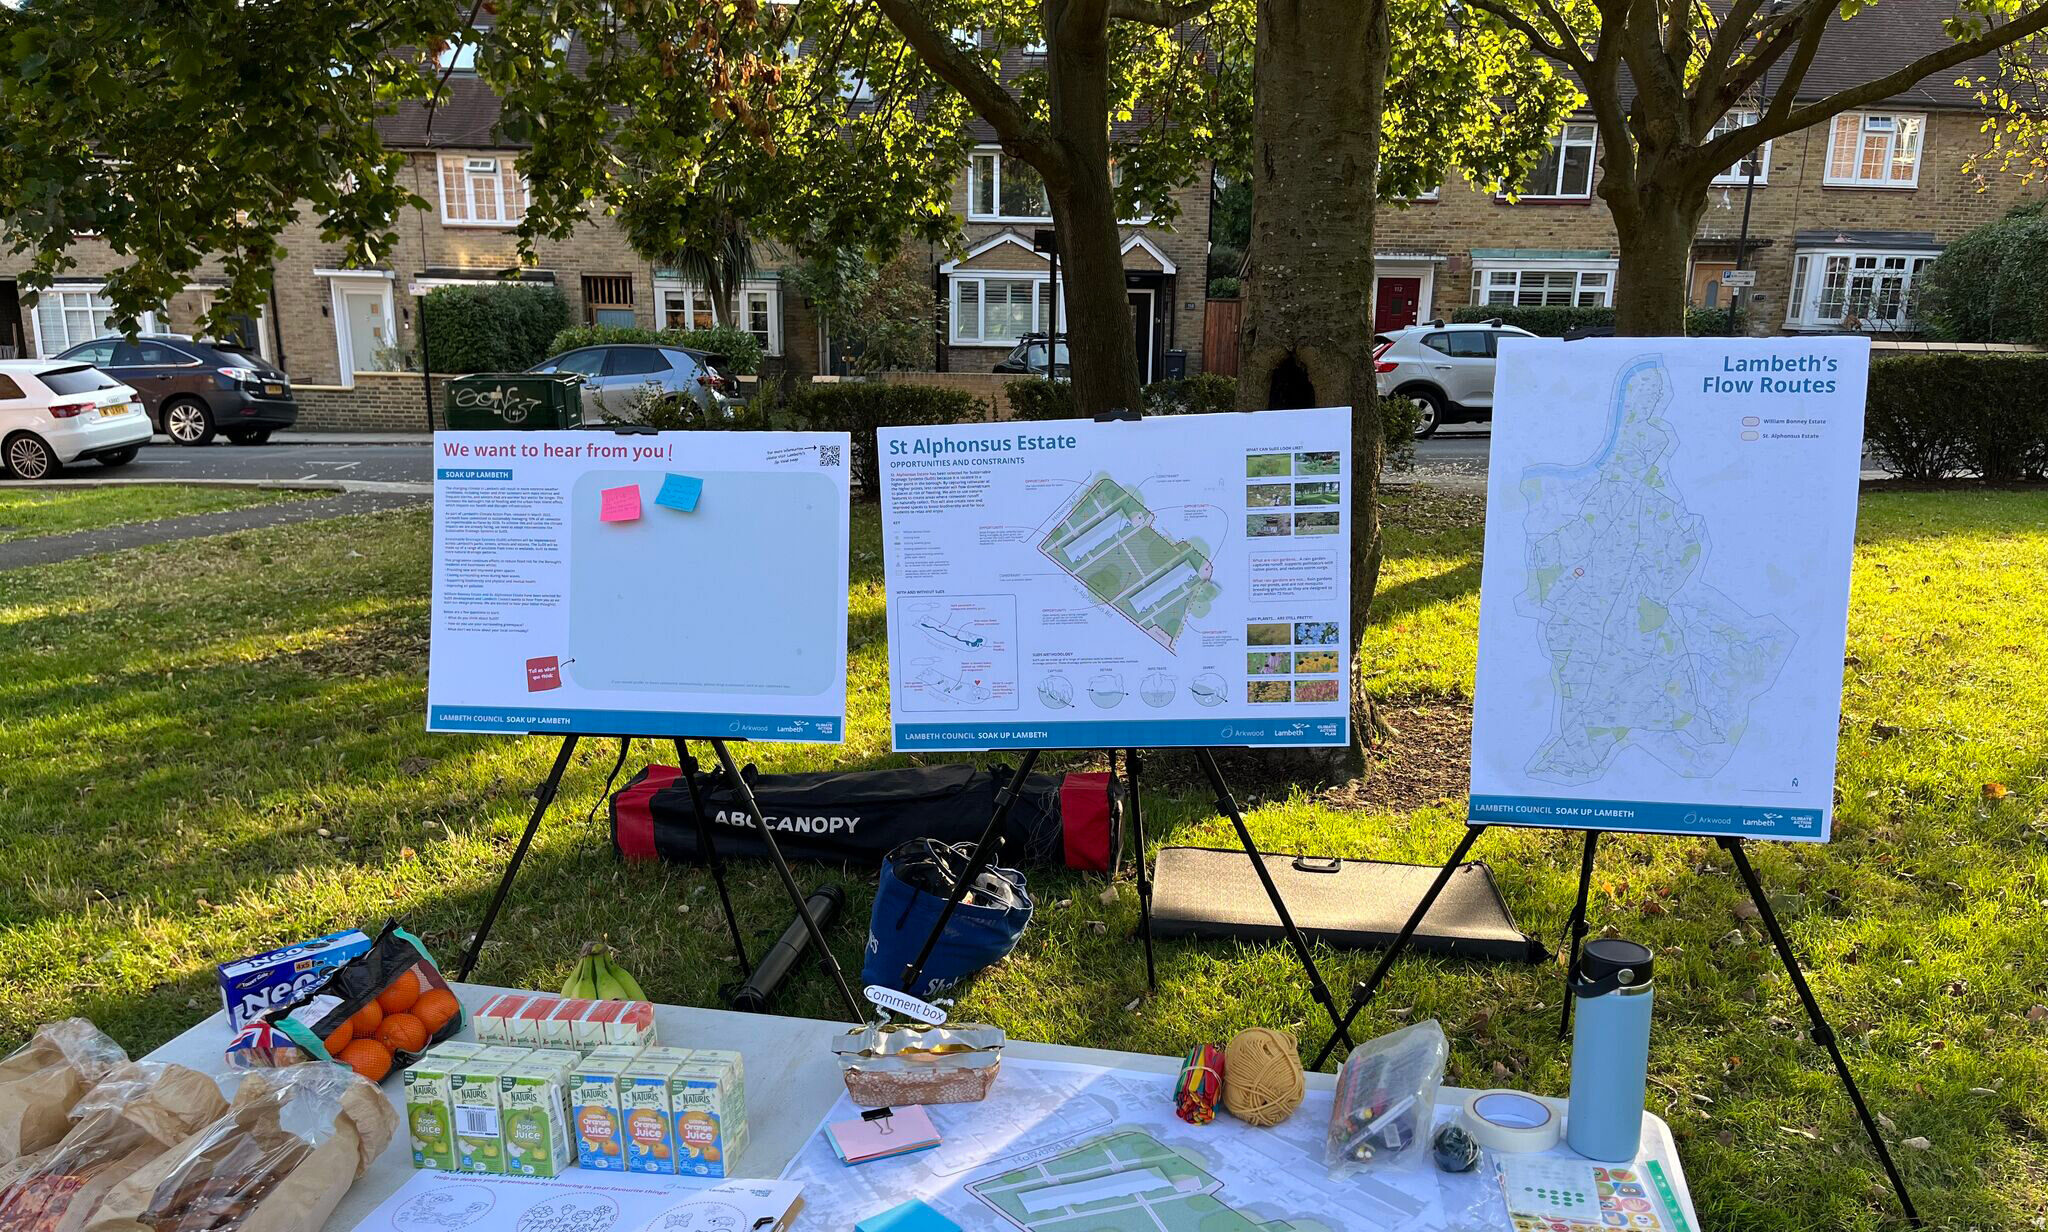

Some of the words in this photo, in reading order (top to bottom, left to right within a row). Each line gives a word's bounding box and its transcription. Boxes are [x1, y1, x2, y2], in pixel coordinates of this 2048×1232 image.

[1703, 377, 1753, 393] Flow
[1760, 377, 1836, 393] Routes
[443, 442, 469, 457] We
[473, 444, 516, 458] want
[520, 443, 539, 458] to
[544, 442, 582, 458] hear
[586, 442, 629, 458] from
[890, 439, 908, 455] St
[913, 437, 1011, 458] Alphonsus
[1018, 434, 1076, 451] Estate
[890, 459, 950, 469] OPPORTUNITIES
[952, 458, 970, 467] AND
[971, 457, 1025, 466] CONSTRAINTS
[446, 471, 465, 479] SOAK
[466, 471, 475, 479] UP
[476, 471, 508, 479] LAMBETH
[1475, 804, 1513, 812] LAMBETH
[1515, 806, 1552, 814] COUNCIL
[1556, 807, 1578, 816] SOAK
[1594, 809, 1634, 818] LAMBETH
[1699, 816, 1731, 825] Arkwood
[250, 947, 304, 968] Neo
[295, 962, 311, 970] 4x5
[865, 987, 921, 1014] Comment
[922, 1004, 944, 1021] box
[413, 1085, 437, 1096] NATURIS
[462, 1089, 487, 1099] NATURIS
[581, 1088, 608, 1100] NATURIS
[511, 1092, 537, 1102] NATURIS
[632, 1091, 659, 1102] NATURIS
[683, 1094, 711, 1105] NATURIS
[583, 1119, 611, 1127] Orange
[634, 1122, 661, 1130] Orange
[684, 1124, 712, 1132] Orange
[416, 1125, 441, 1134] Juice
[584, 1126, 611, 1135] Juice
[635, 1129, 662, 1138] Juice
[514, 1130, 541, 1140] Juice
[685, 1132, 713, 1140] Juice
[1012, 1145, 1063, 1164] Holwood
